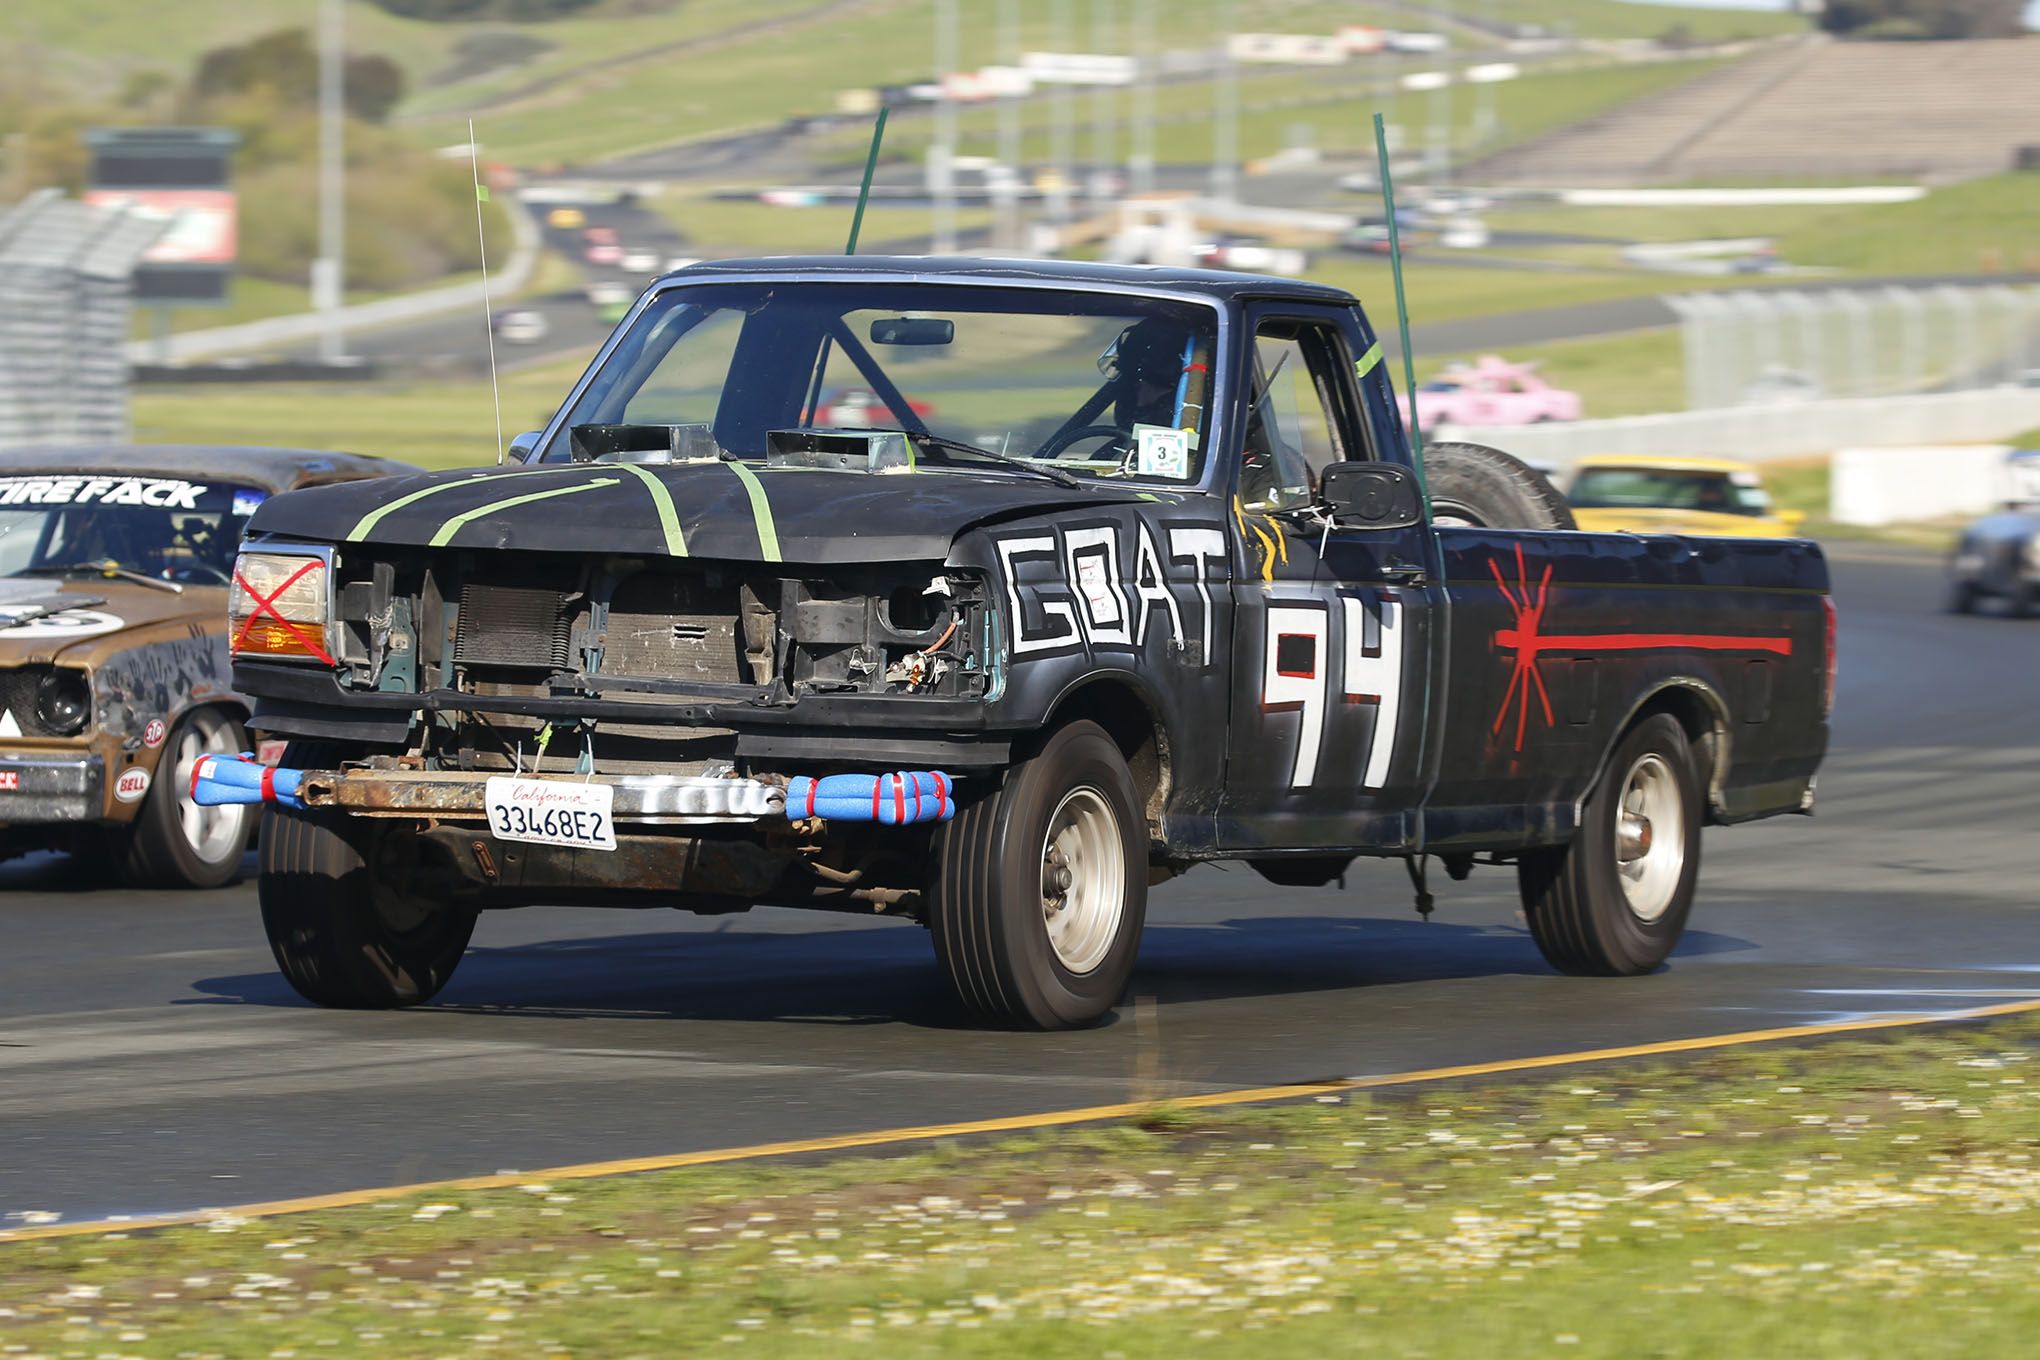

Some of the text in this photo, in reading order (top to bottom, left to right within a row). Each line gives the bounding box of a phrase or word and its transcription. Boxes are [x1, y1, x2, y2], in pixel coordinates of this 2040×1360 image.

[1157, 446, 1166, 460] 3
[996, 520, 1227, 667] GOAT
[1263, 596, 1402, 789] 94
[145, 721, 162, 741] STP
[119, 775, 145, 793] BELL
[511, 783, 589, 807] California
[494, 804, 607, 842] 33468E2
